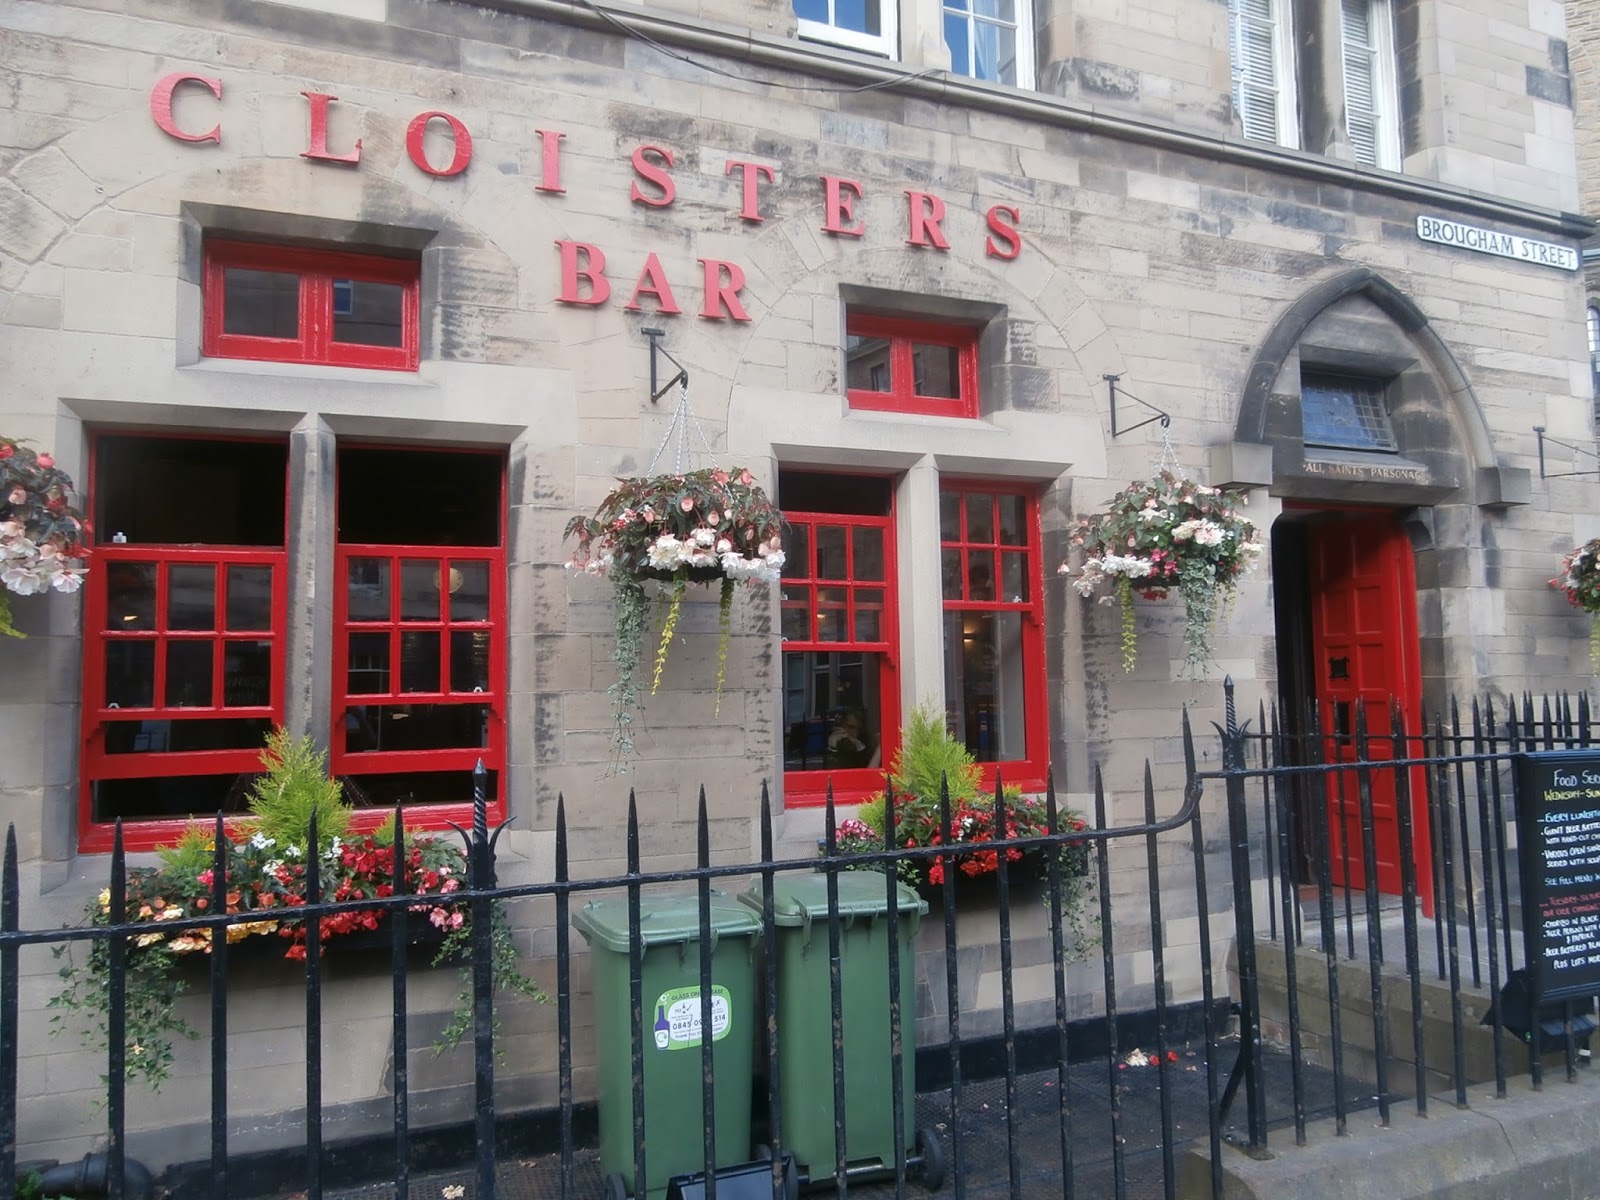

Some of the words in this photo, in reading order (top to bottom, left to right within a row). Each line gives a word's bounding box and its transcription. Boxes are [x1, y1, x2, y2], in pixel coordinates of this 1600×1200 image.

[150, 71, 1022, 261] CLOISTERS
[1422, 218, 1515, 255] BROUGHAM
[1521, 240, 1573, 267] STREET
[554, 239, 751, 322] BAR
[1328, 465, 1364, 476] SAINTS
[1371, 467, 1427, 481] PARSONAG
[1545, 812, 1569, 822] EVERY
[1565, 825, 1582, 834] BEER
[1581, 822, 1600, 831] BATTE
[1569, 845, 1586, 856] OPEN
[1569, 858, 1585, 866] WITH
[1544, 877, 1558, 886] SEE
[1558, 875, 1574, 885] FULL
[1574, 873, 1594, 883] MENU
[1545, 947, 1560, 957] BEER
[1553, 959, 1569, 970] PLUS
[1570, 956, 1586, 968] LOTS
[671, 992, 690, 1001] GLASS
[672, 1020, 691, 1030] 0845
[714, 1013, 726, 1022] 514
